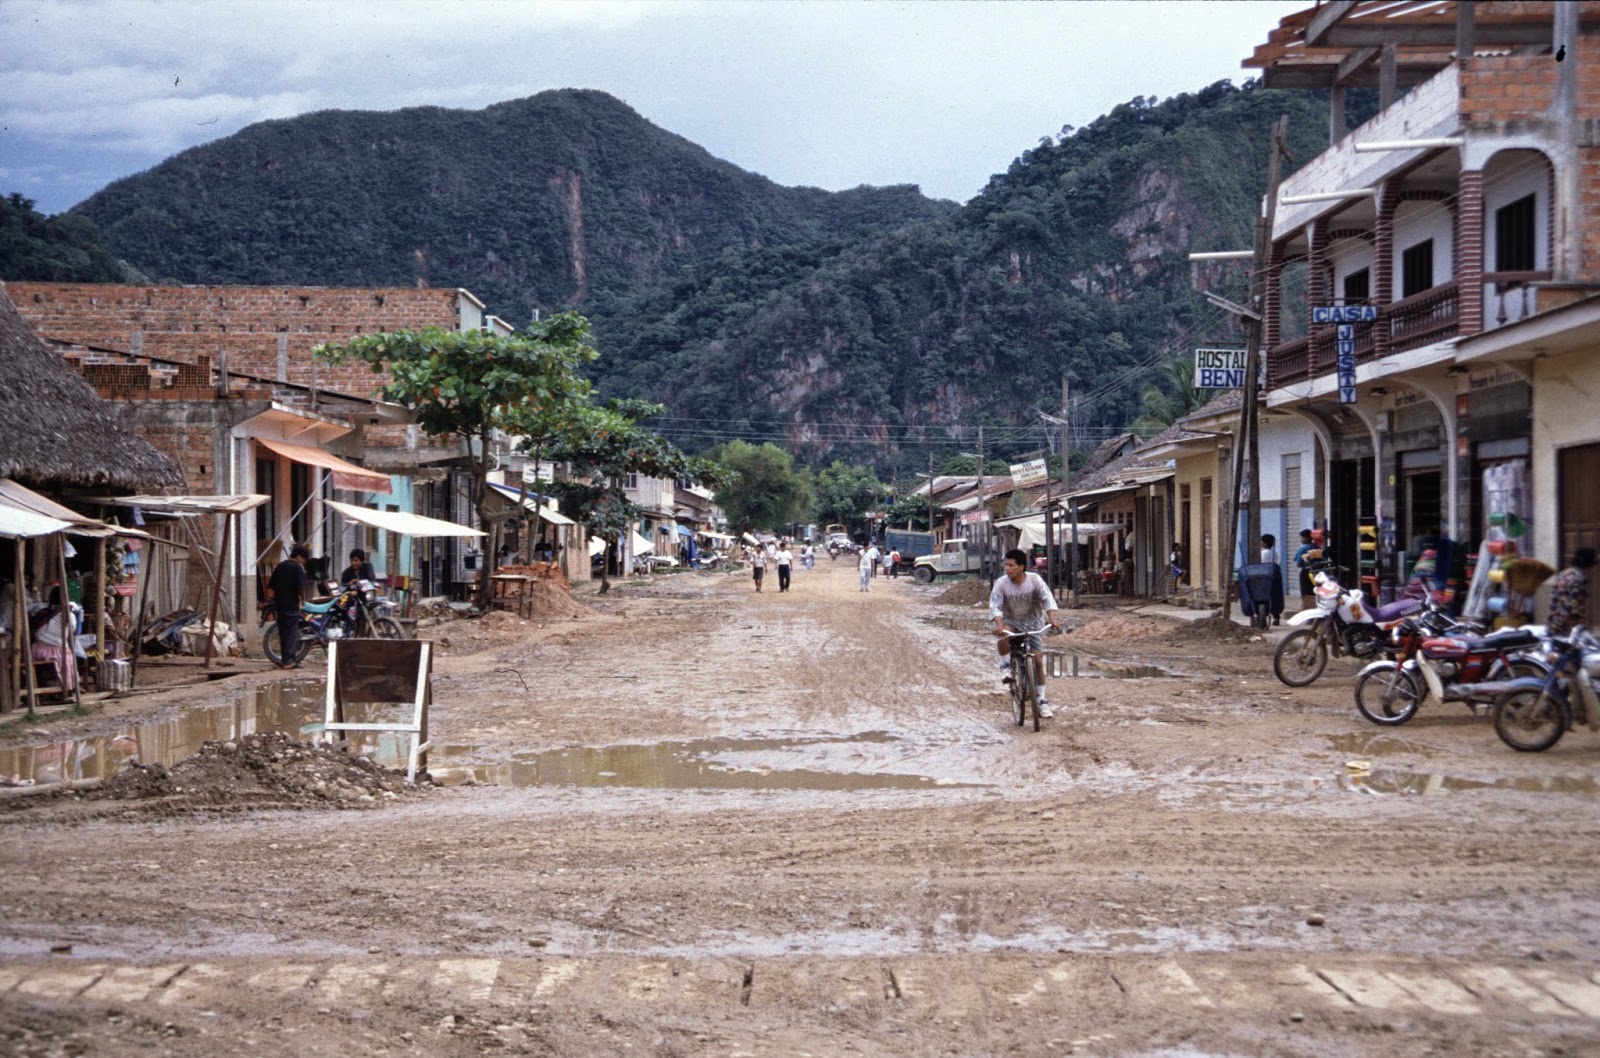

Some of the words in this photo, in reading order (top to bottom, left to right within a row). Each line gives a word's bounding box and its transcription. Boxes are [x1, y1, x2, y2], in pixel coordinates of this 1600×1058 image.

[1314, 307, 1375, 322] CASA
[1197, 350, 1246, 369] HOSTAL
[1340, 325, 1355, 402] JUSTY
[1200, 369, 1244, 387] BENI
